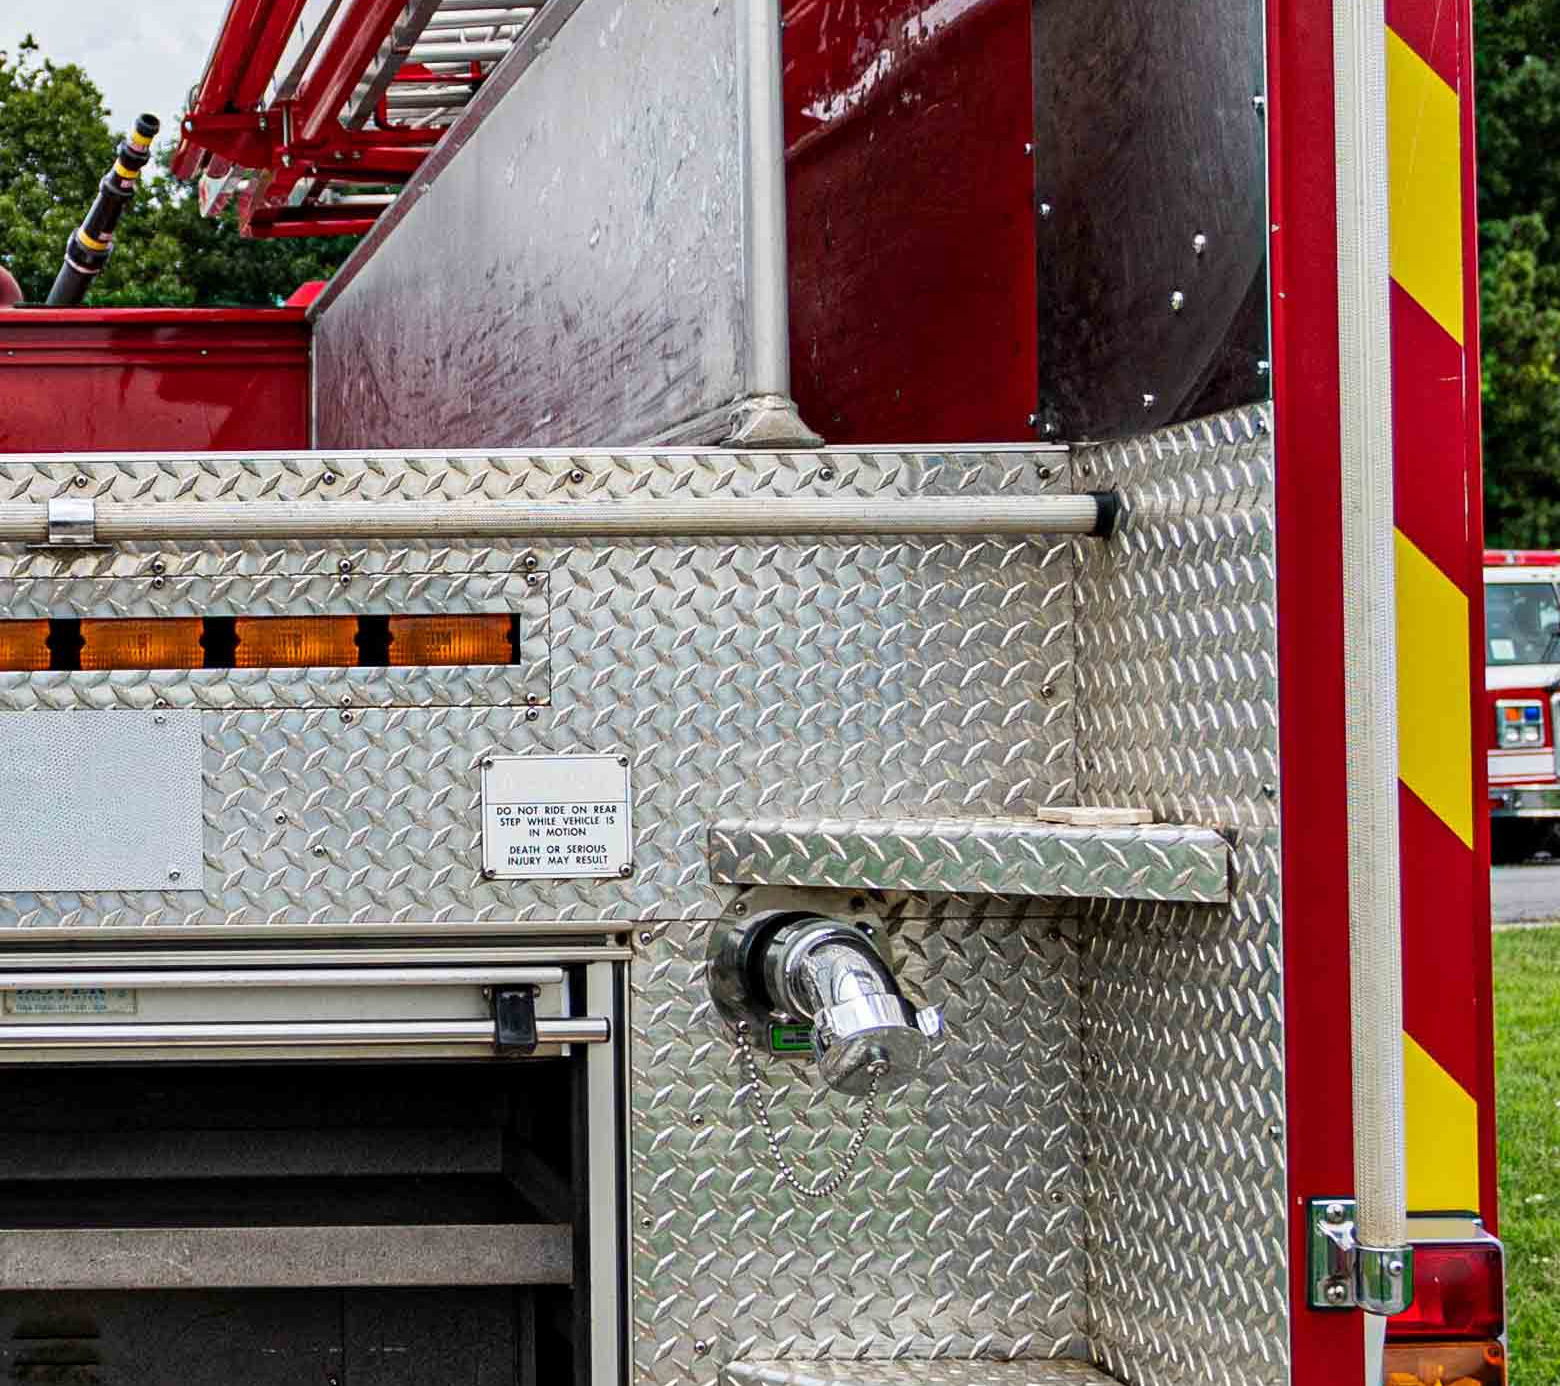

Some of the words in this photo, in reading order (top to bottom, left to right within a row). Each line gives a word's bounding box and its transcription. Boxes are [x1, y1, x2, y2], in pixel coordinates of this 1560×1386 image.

[496, 806, 512, 815] DO
[517, 806, 538, 815] NOT
[544, 805, 566, 815] RIDE
[571, 805, 587, 814] ON
[593, 805, 617, 814] REAR
[500, 817, 521, 827] STEP
[527, 816, 556, 826] WHILE
[562, 816, 599, 825] VEHICLE
[606, 816, 615, 825] IS
[529, 828, 540, 837] IN
[545, 827, 587, 837] MOTION
[509, 845, 540, 854] DEATH
[546, 845, 560, 854] OR
[566, 844, 607, 853] SERIOUS
[507, 856, 541, 866] INJURY
[547, 855, 569, 865] MAY
[575, 855, 608, 864] RESULT
